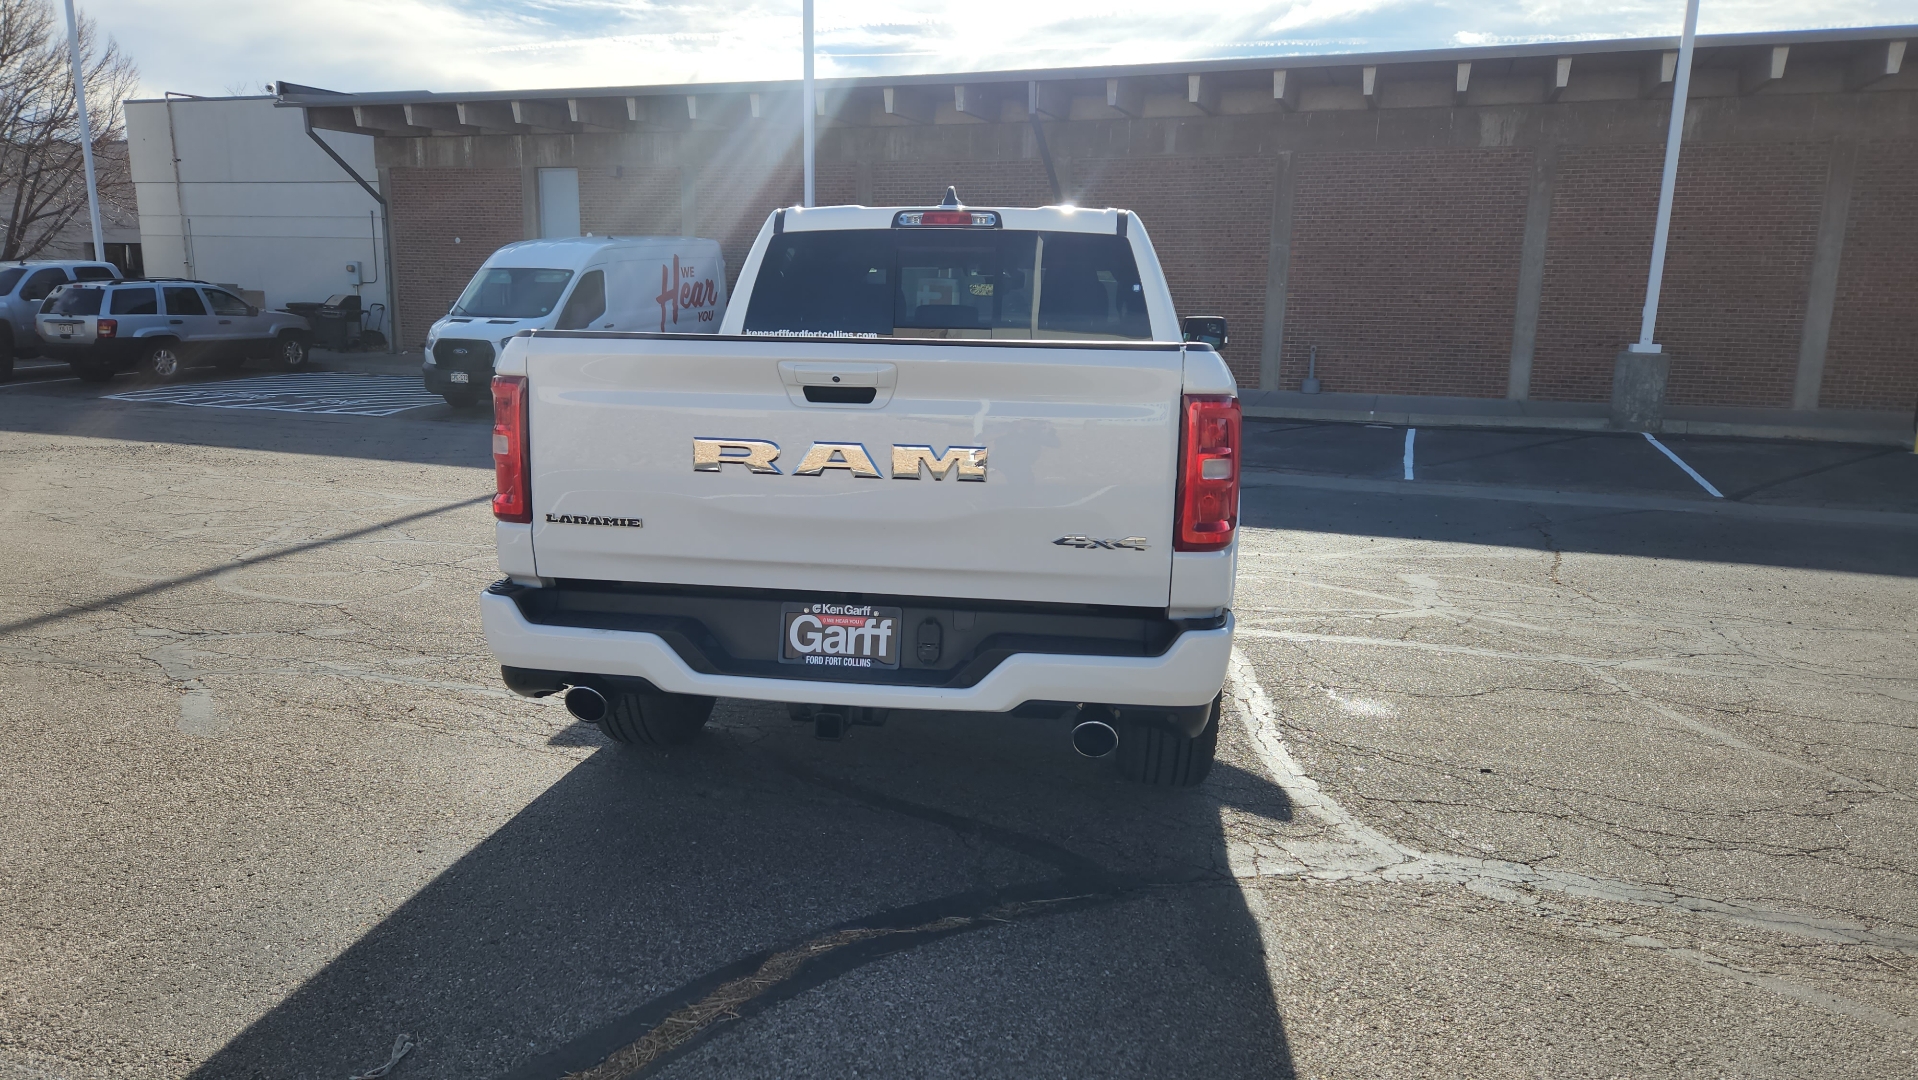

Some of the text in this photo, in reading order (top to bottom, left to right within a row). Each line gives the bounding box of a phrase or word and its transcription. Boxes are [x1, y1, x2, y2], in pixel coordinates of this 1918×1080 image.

[681, 266, 695, 278] WE
[656, 253, 718, 333] Hear
[698, 310, 714, 322] YOU
[692, 437, 988, 482] RAM
[545, 513, 643, 528] LARAMIE
[822, 604, 871, 616] Ken Garff
[789, 614, 892, 657] Garff
[805, 655, 871, 668] FORD FORT COLLINS
